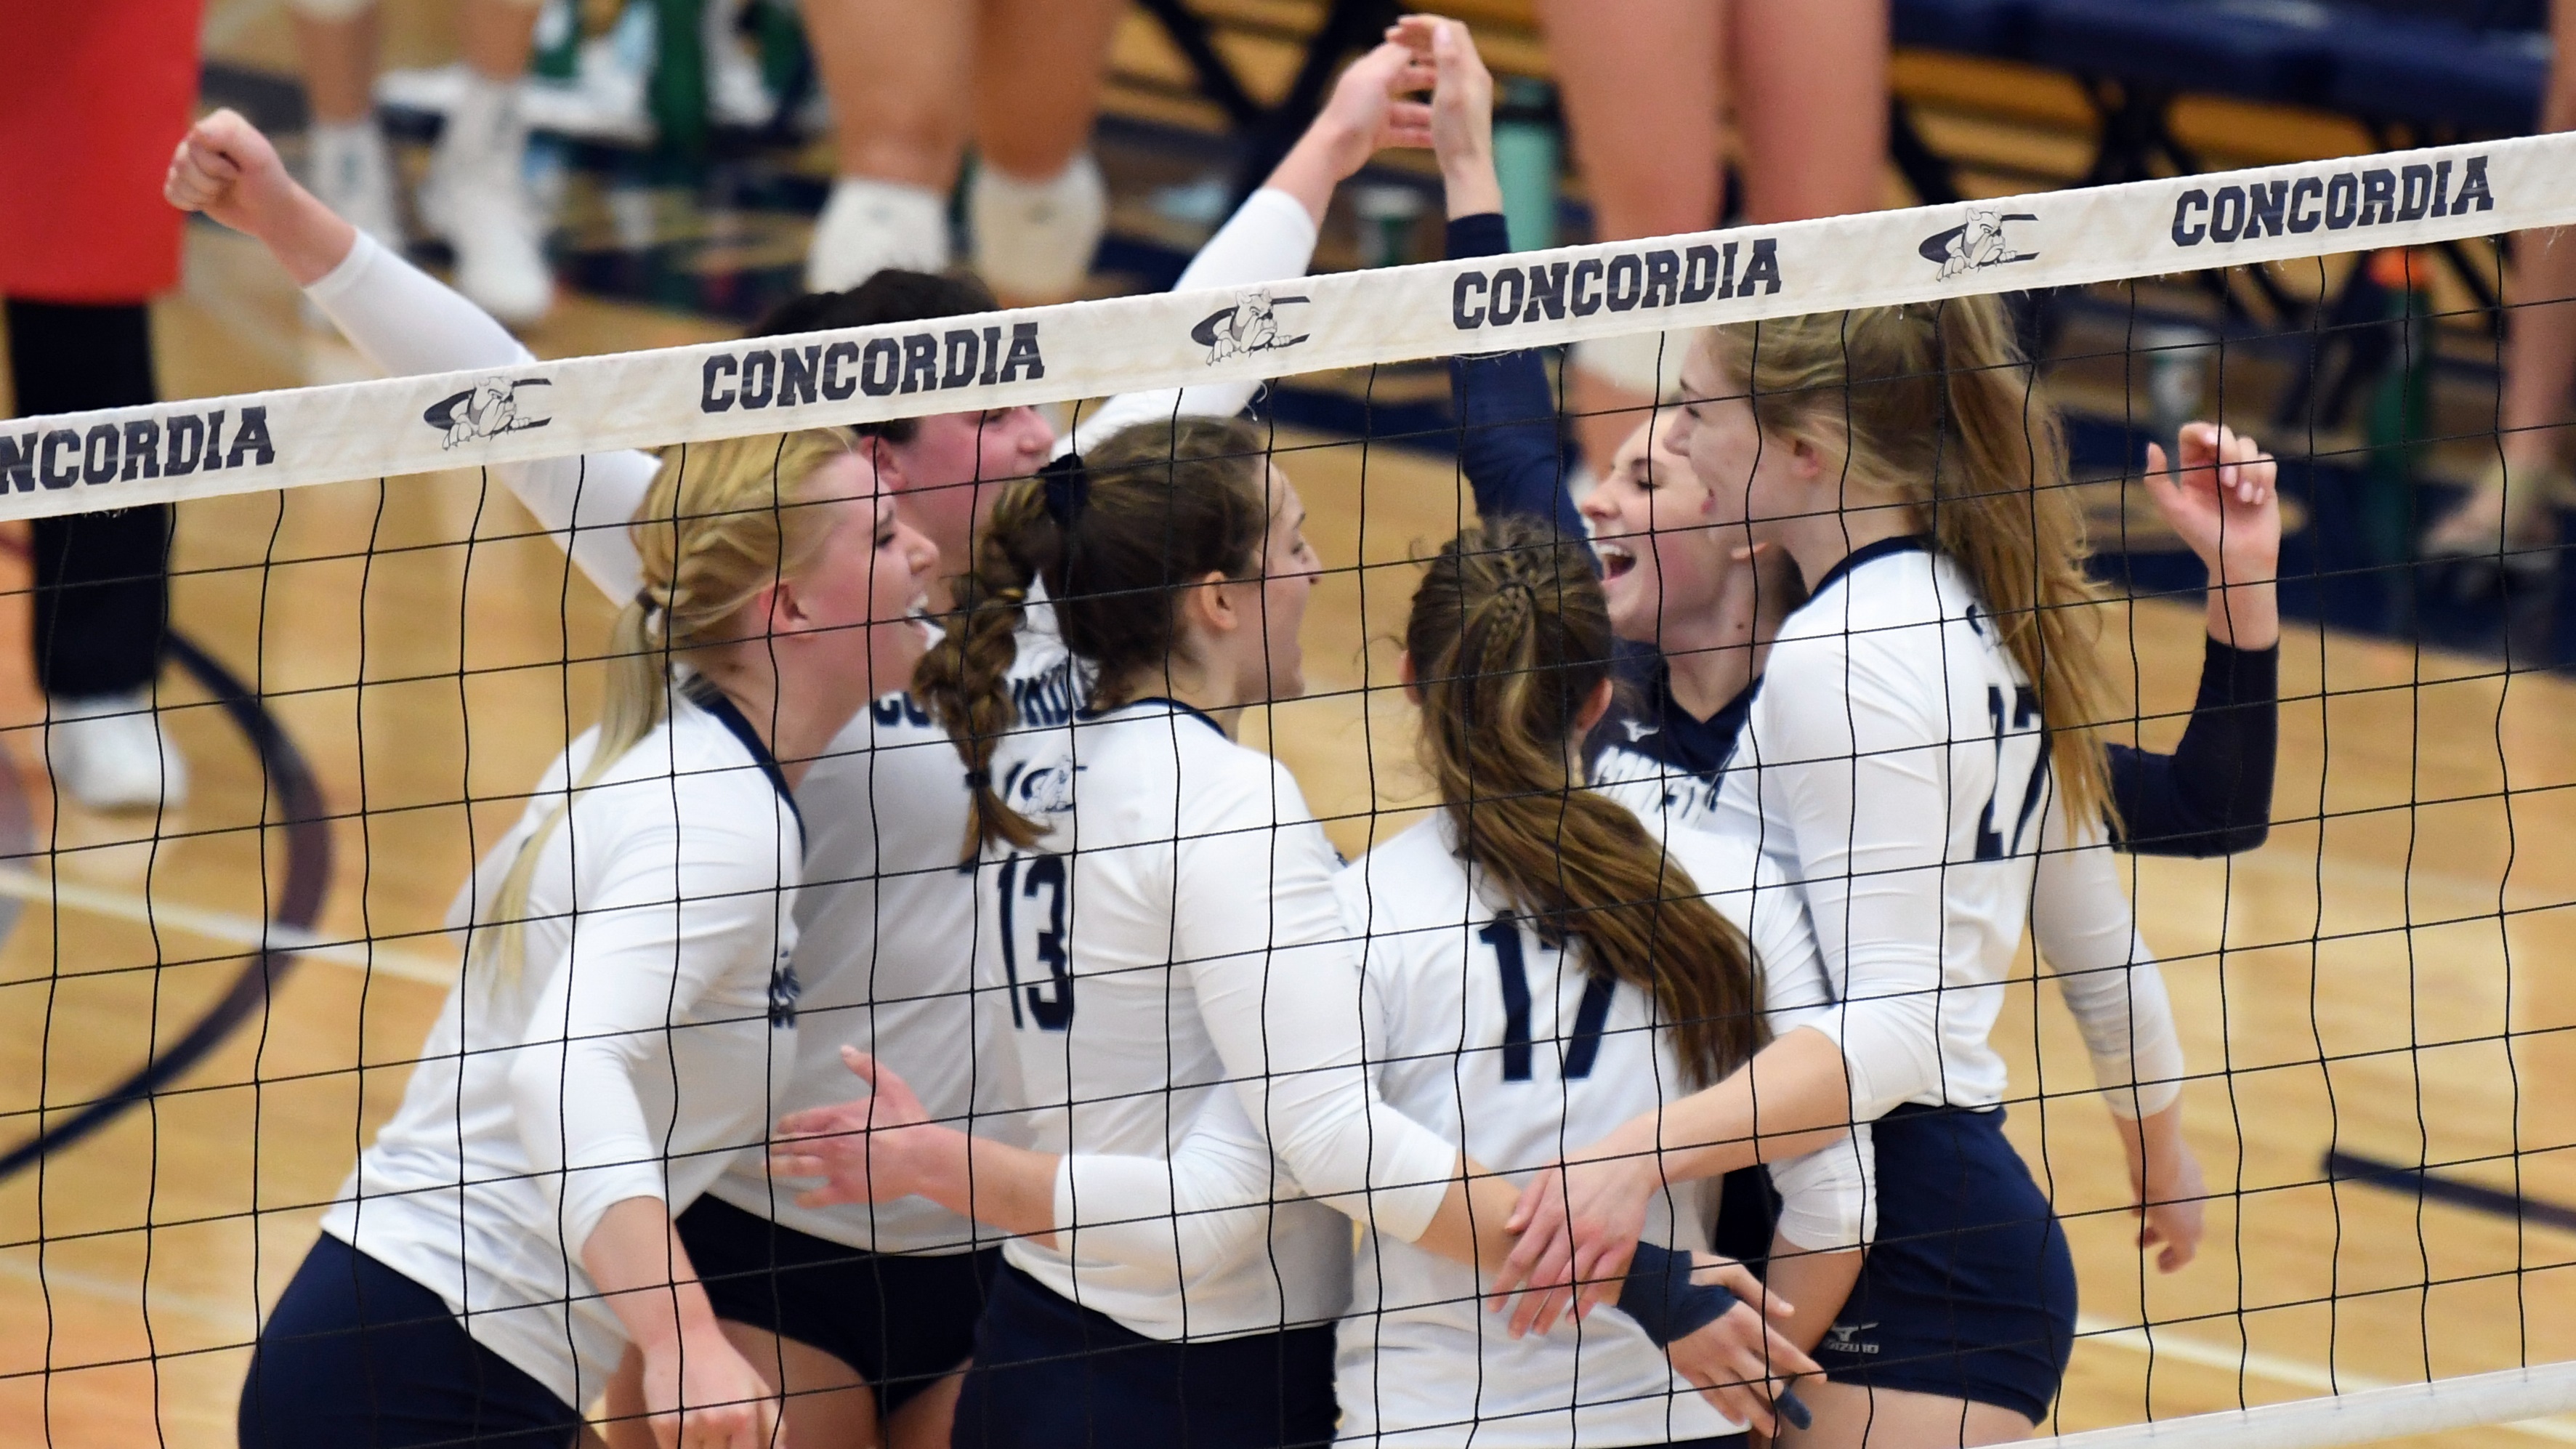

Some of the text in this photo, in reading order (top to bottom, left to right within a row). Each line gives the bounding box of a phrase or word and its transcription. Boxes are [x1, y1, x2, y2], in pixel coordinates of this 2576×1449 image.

[2171, 156, 2494, 247] CONCORDIA
[1453, 238, 1782, 330] CONCORDIA
[700, 322, 1045, 413] CONCORDIA
[0, 406, 275, 495] NCORDIA
[997, 852, 1073, 1031] 13
[1478, 910, 1621, 1081] 17
